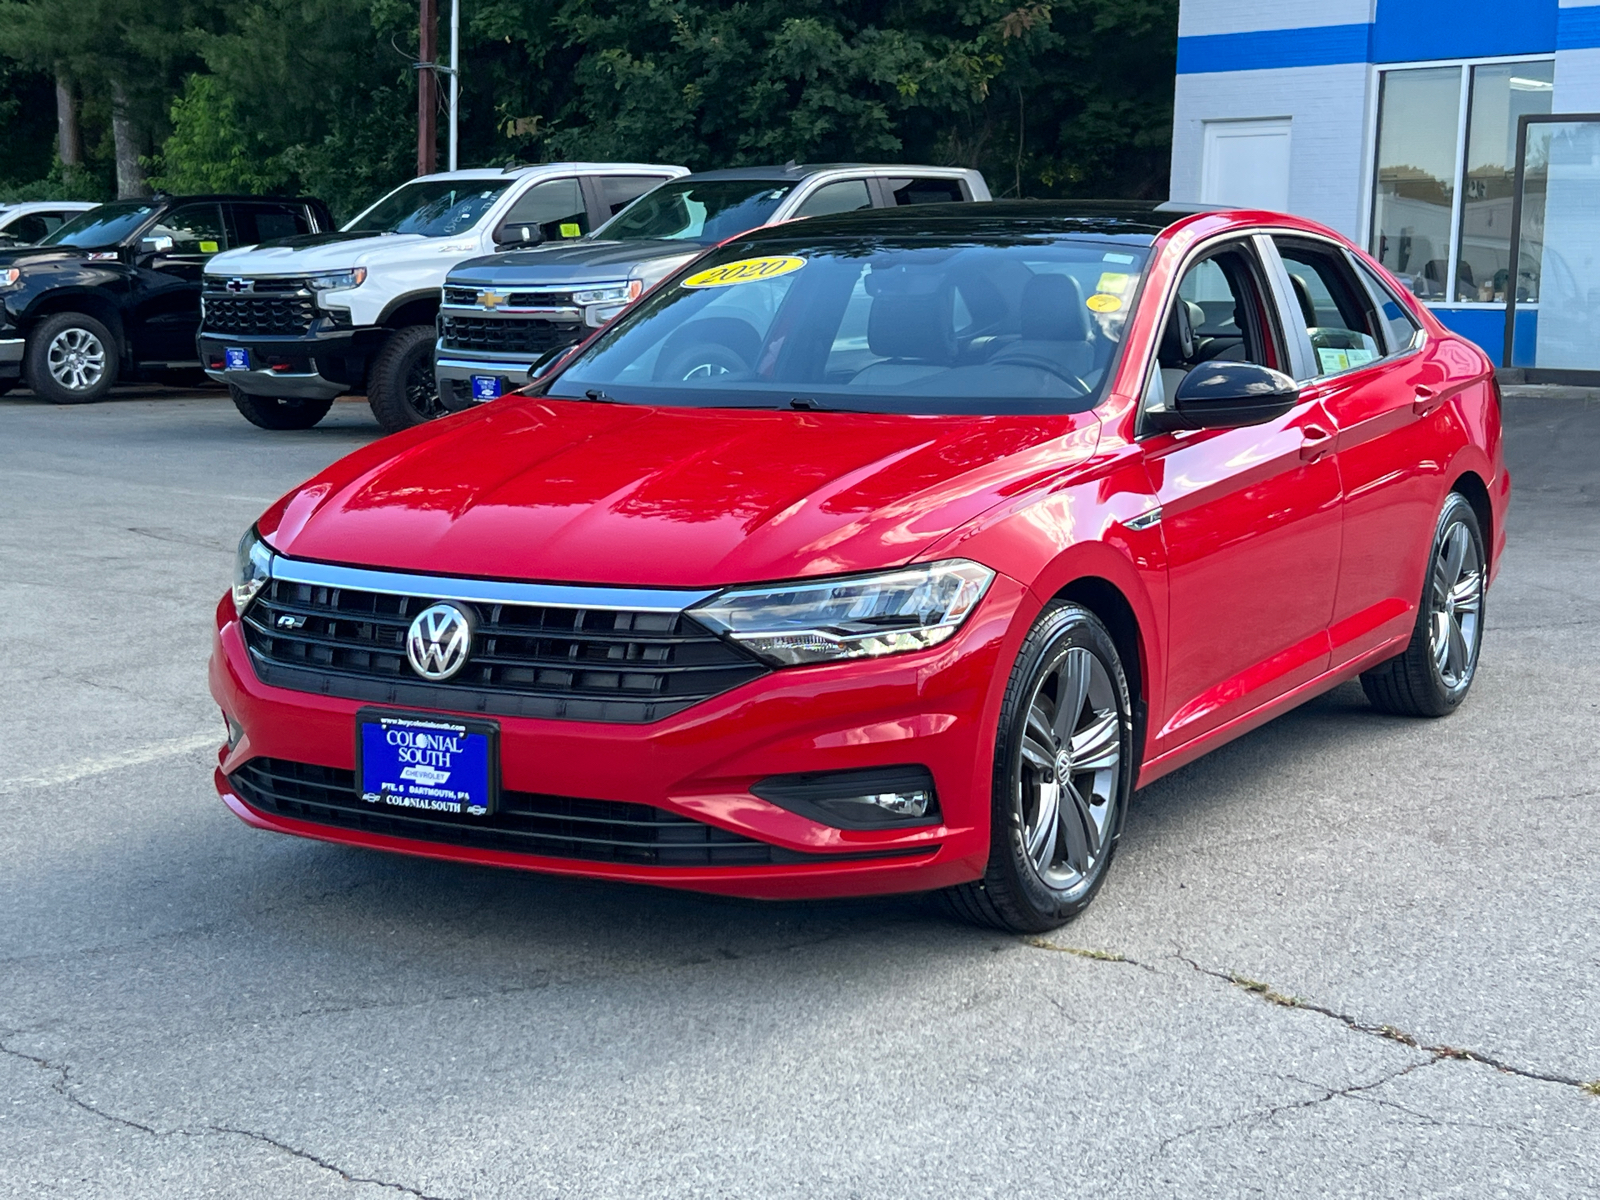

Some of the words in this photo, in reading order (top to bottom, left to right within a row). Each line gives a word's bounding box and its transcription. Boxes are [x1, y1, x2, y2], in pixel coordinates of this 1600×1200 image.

[698, 260, 788, 284] 2020
[386, 730, 463, 753] COLONIAL
[399, 747, 451, 767] SOUTH
[406, 770, 445, 780] CHEVROLET
[409, 786, 456, 799] DARTMOUTH,
[386, 795, 431, 809] COLONIAL
[431, 799, 462, 813] SOUTH
